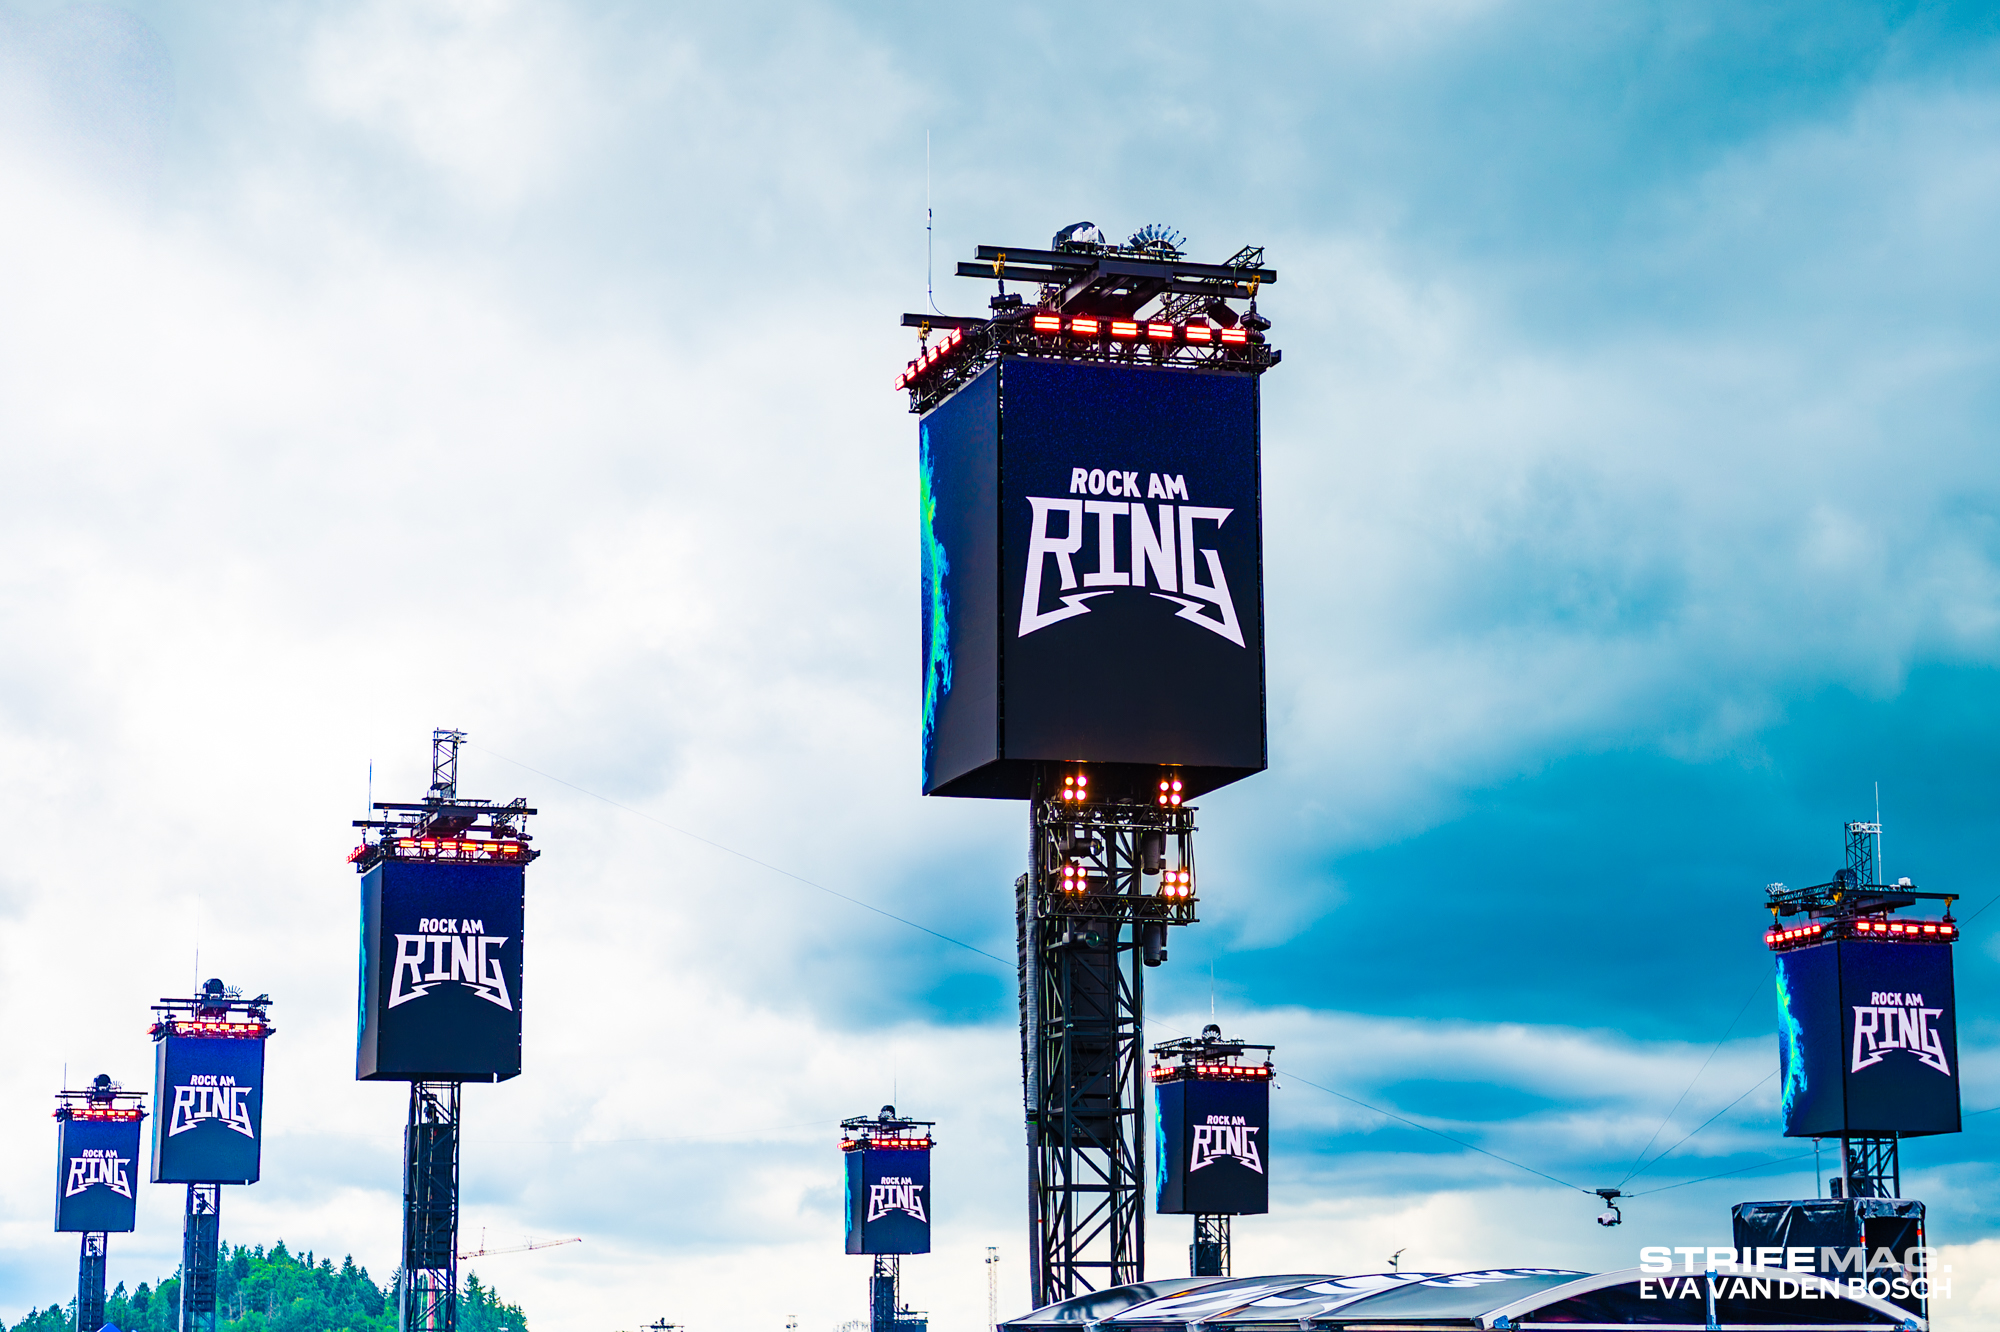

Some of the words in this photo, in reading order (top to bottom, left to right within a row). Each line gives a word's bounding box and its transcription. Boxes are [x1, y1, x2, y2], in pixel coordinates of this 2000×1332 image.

[1069, 467, 1142, 498] ROCK
[1148, 473, 1189, 501] AM
[1017, 497, 1247, 649] RING
[418, 917, 459, 934] ROCK
[461, 918, 485, 935] AM
[388, 933, 513, 1012] RING
[1870, 991, 1903, 1006] ROCK
[1905, 992, 1924, 1007] AM
[1851, 1005, 1951, 1077] RING
[190, 1074, 217, 1087] ROCK
[220, 1075, 236, 1088] AM
[168, 1086, 255, 1139] RING
[1206, 1114, 1231, 1126] ROCK
[1232, 1115, 1246, 1126] AM
[82, 1149, 104, 1159] ROCK
[105, 1149, 118, 1159] AM
[1189, 1124, 1264, 1175] RING
[65, 1158, 133, 1199] RING
[880, 1176, 900, 1186] ROCK
[901, 1176, 913, 1186] AM
[866, 1185, 928, 1223] RING
